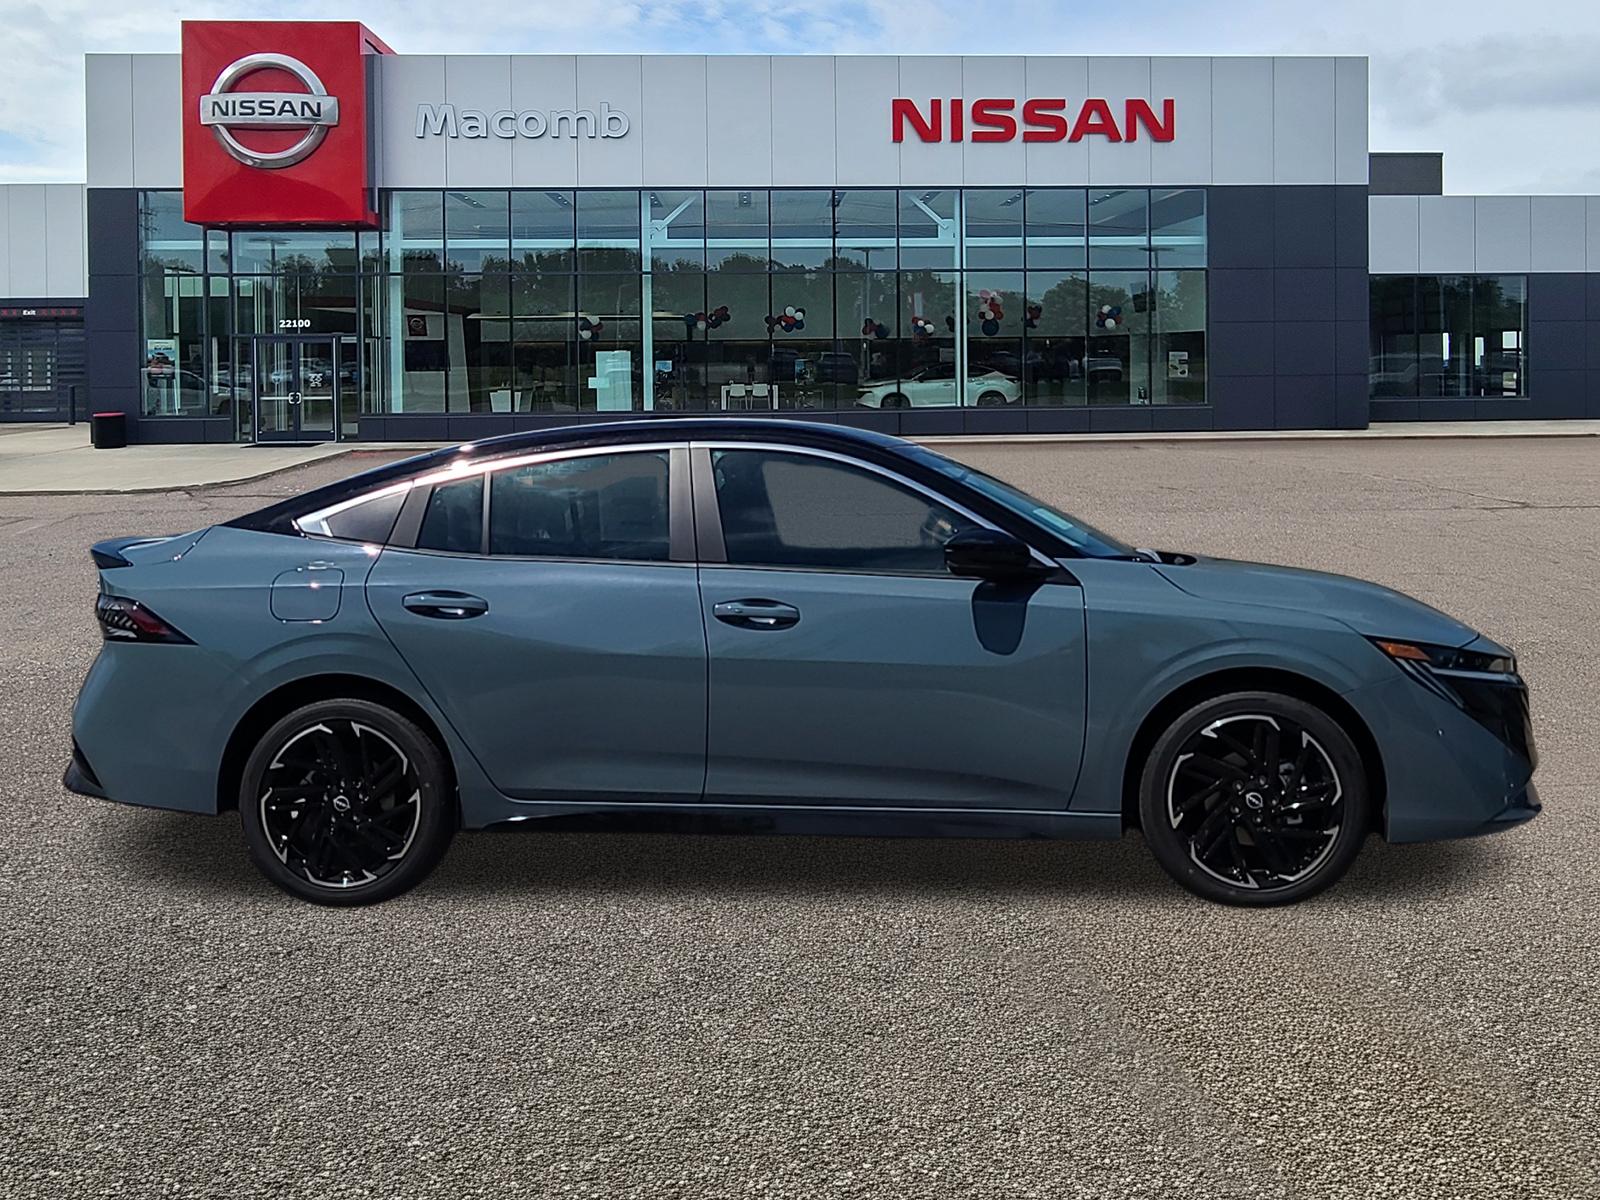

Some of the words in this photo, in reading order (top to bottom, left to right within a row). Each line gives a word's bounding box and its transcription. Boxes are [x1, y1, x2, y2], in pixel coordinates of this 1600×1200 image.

[212, 100, 321, 117] NISSAN
[415, 102, 630, 139] Macomb
[892, 98, 1175, 143] NISSAN
[279, 319, 311, 328] 22100
